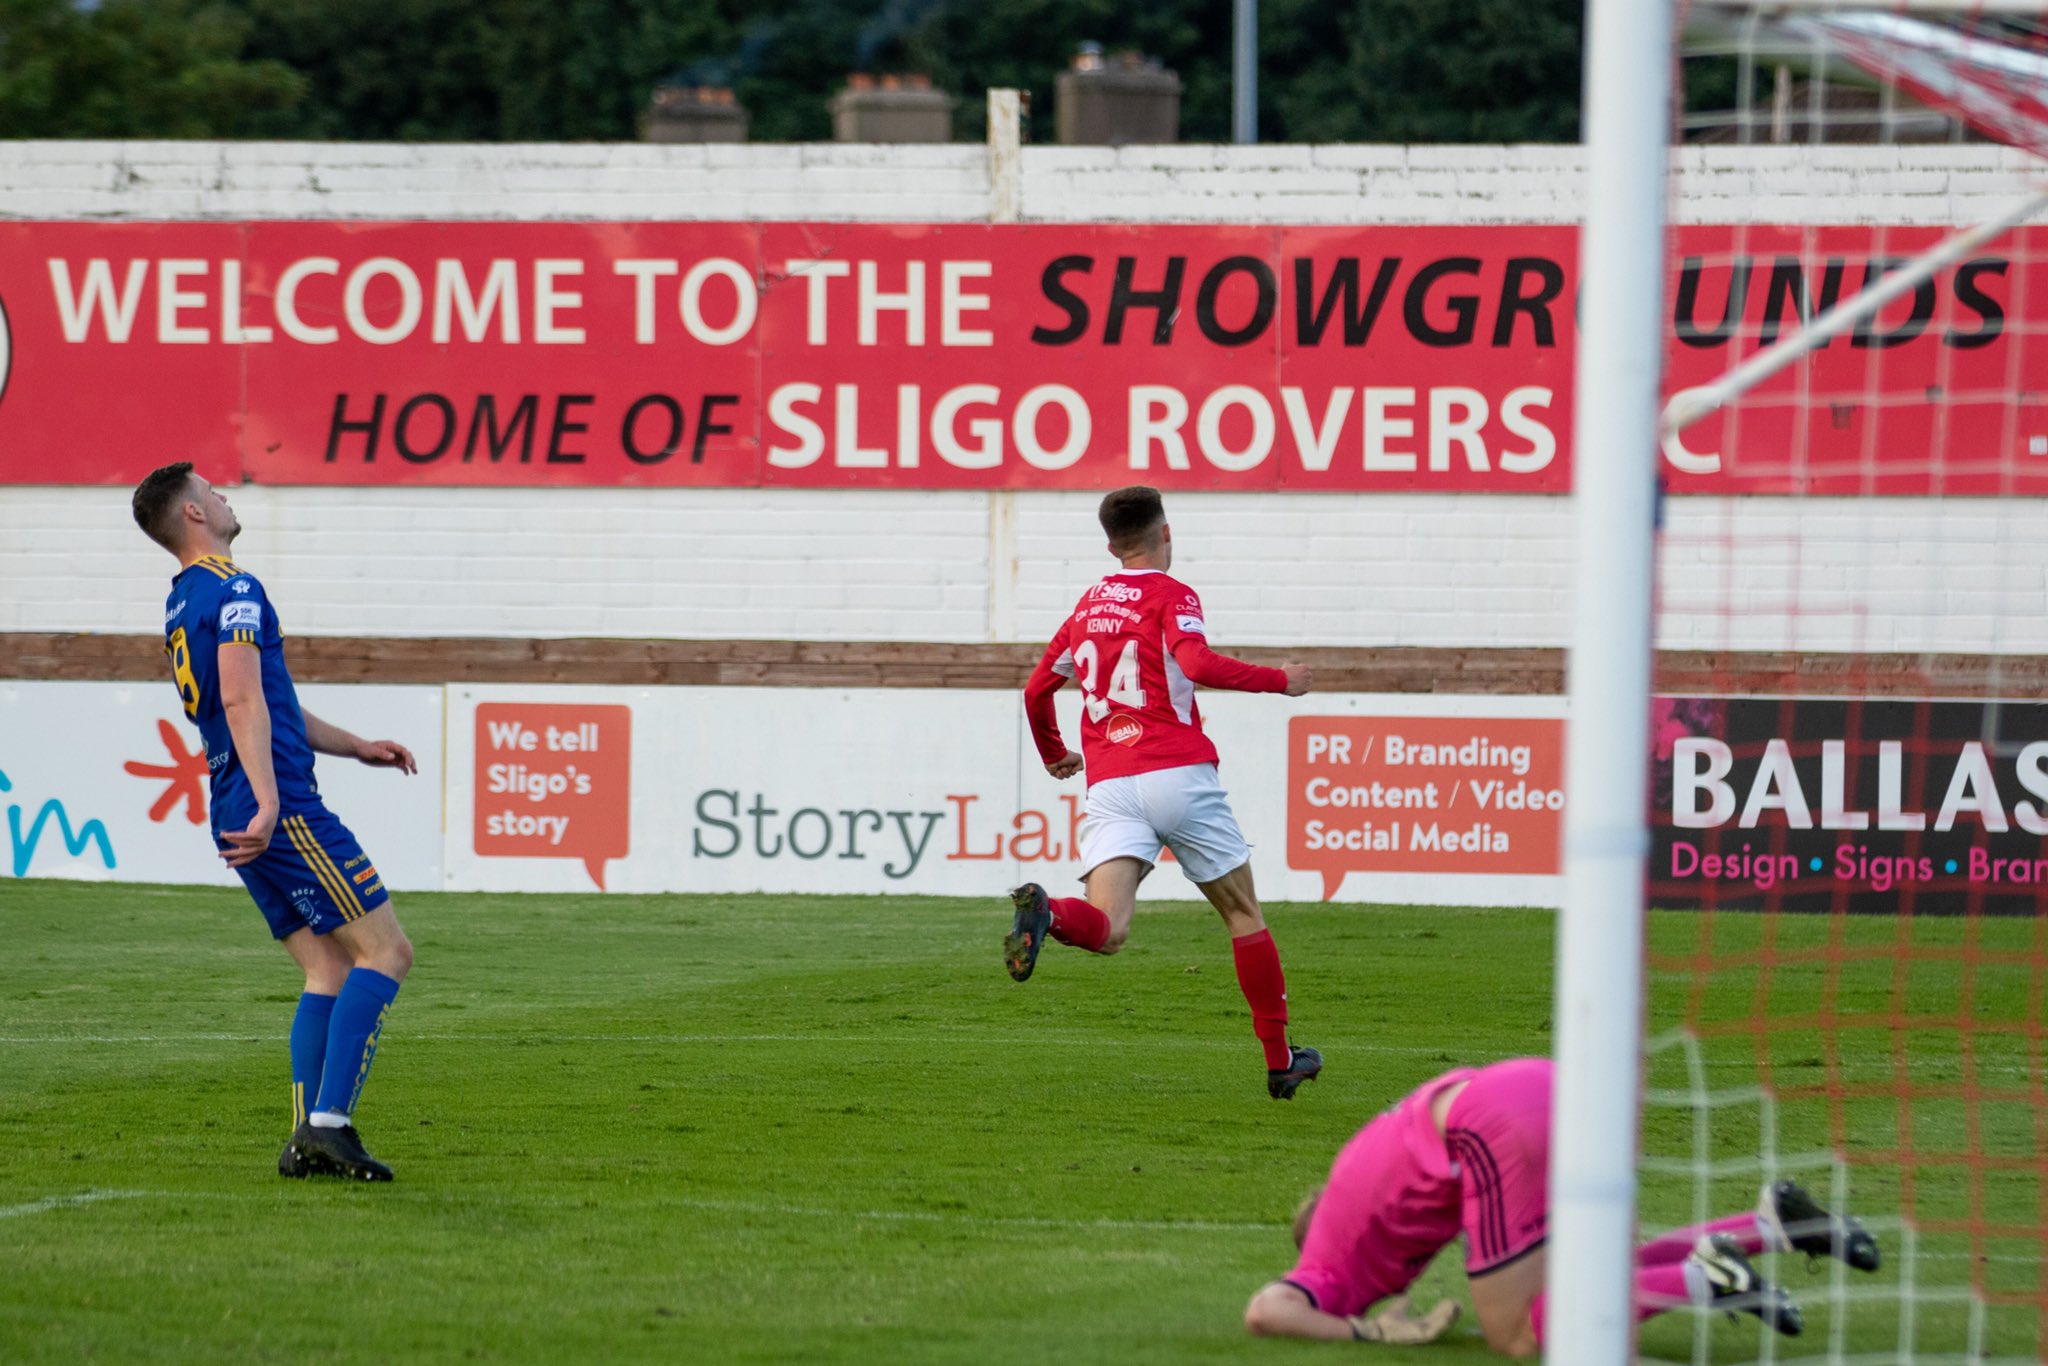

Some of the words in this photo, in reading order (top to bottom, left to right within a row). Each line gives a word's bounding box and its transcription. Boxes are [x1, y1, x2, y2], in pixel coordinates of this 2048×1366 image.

[47, 257, 586, 345] WELCOME
[614, 257, 758, 345] TO
[785, 259, 994, 346] THE
[1030, 254, 2009, 350] SHOWGRUNDS
[324, 393, 596, 465] HOME
[621, 394, 741, 465] OF
[766, 382, 1092, 471] SLIGO
[1128, 384, 1557, 473] ROVERS
[1086, 618, 1123, 634] KENNY
[1074, 640, 1147, 724] 24
[487, 721, 539, 751] We
[545, 723, 598, 751] tell
[1306, 733, 1351, 765] PR
[1384, 734, 1531, 776] Branding
[1305, 776, 1439, 809] Content
[1469, 779, 1566, 811] Video
[486, 810, 569, 846] story
[1304, 819, 1400, 851] Social
[1408, 822, 1510, 853] Media
[1670, 842, 1799, 890] Design
[1834, 846, 1934, 892] Signs
